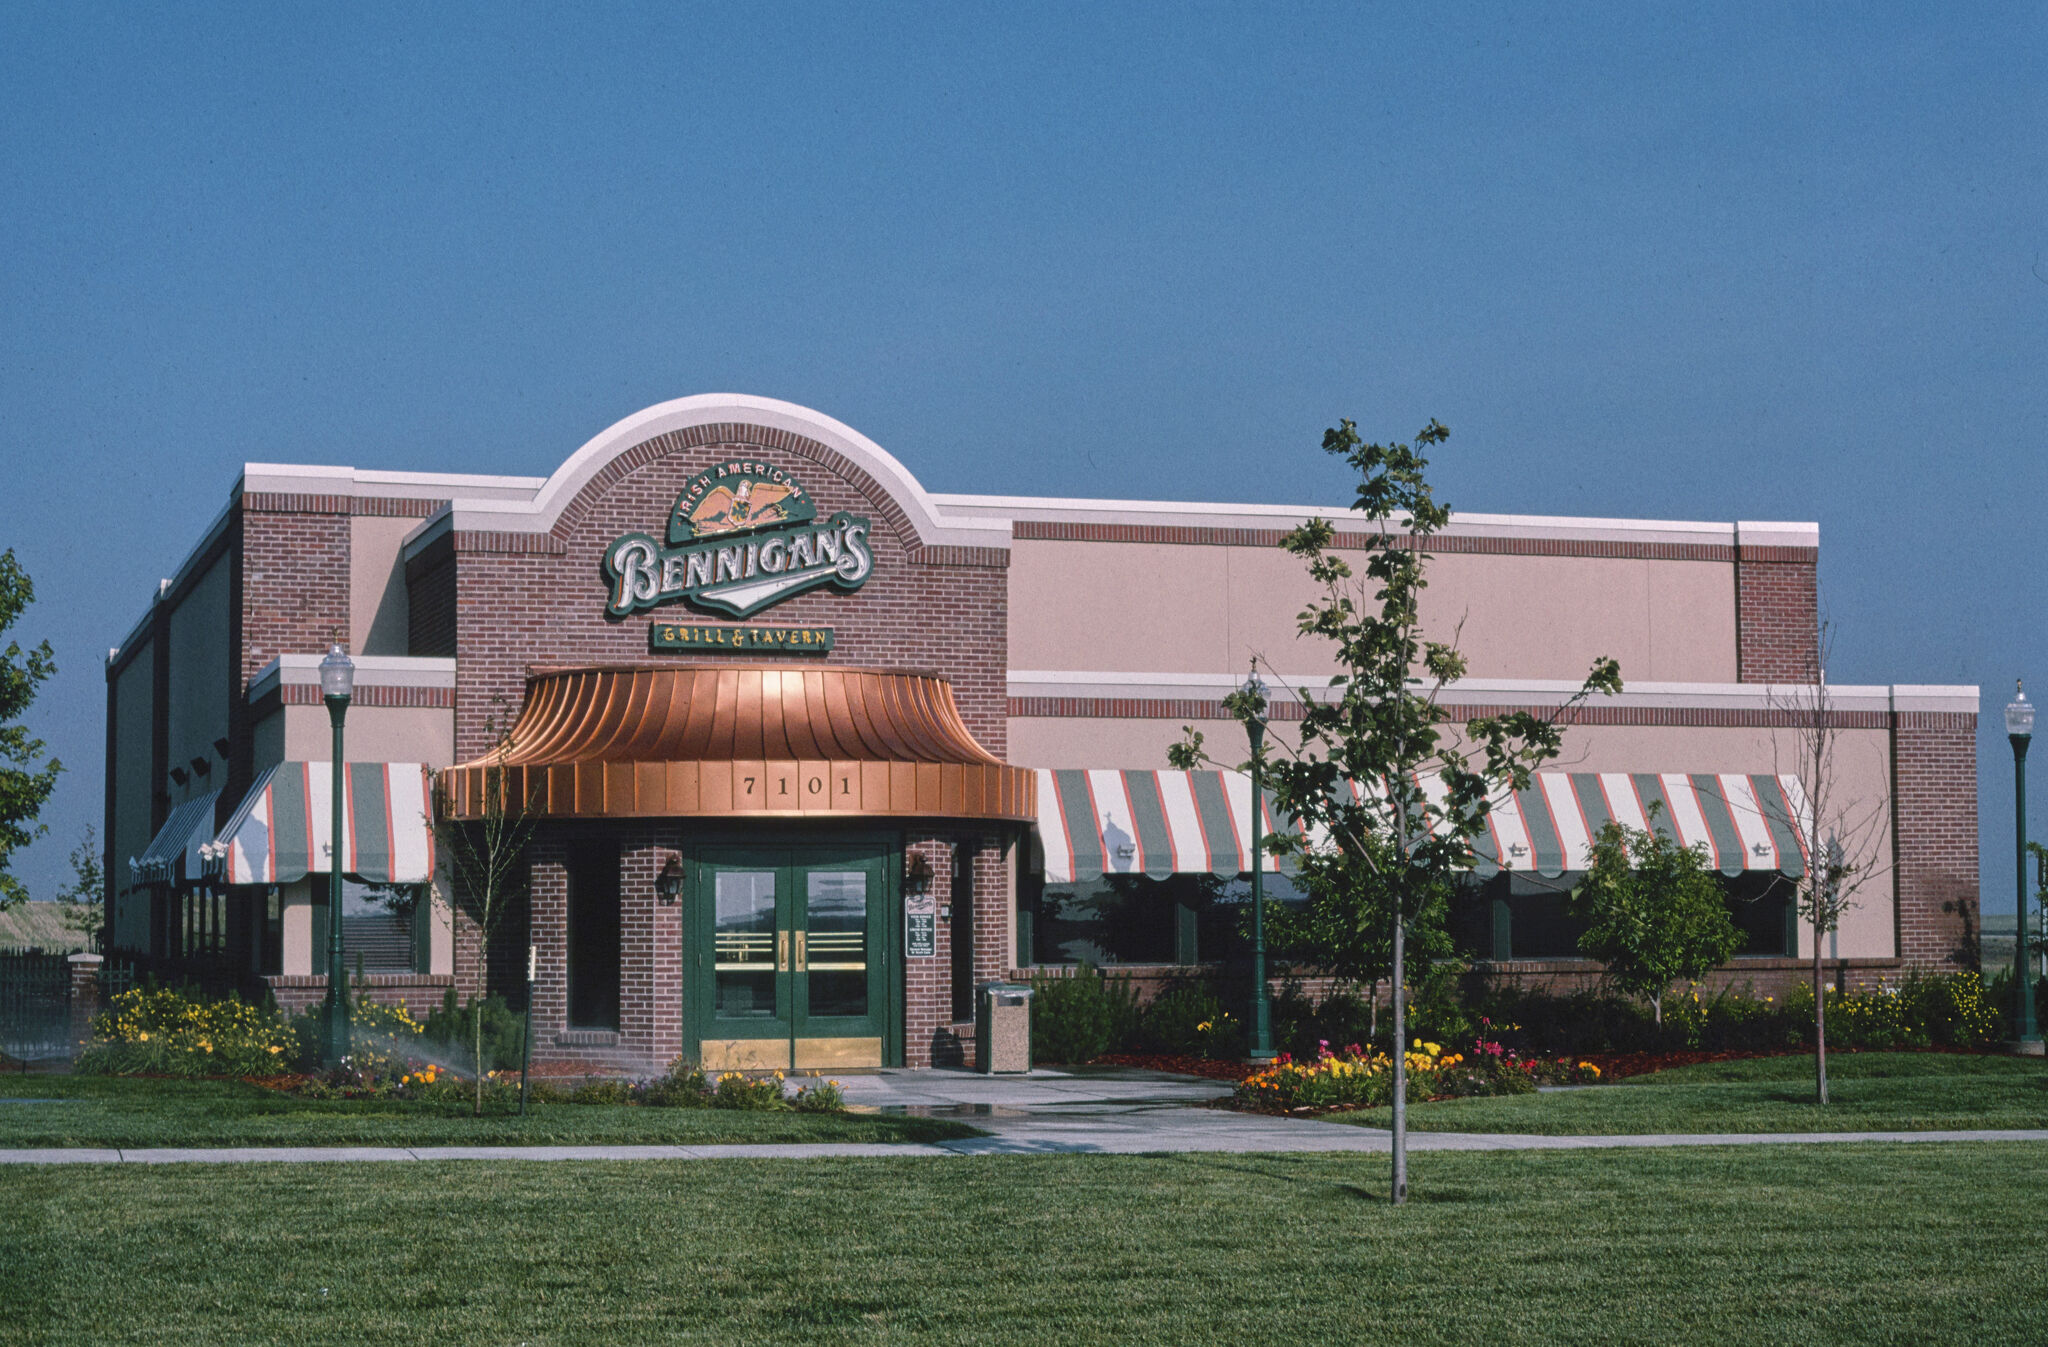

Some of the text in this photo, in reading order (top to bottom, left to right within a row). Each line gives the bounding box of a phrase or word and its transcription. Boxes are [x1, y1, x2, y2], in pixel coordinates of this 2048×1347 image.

[677, 463, 802, 518] IRISH AMERICAN
[613, 518, 871, 608] BENNIGAN'S
[663, 627, 826, 647] GRILL & TAVERN
[743, 776, 851, 795] 7101
